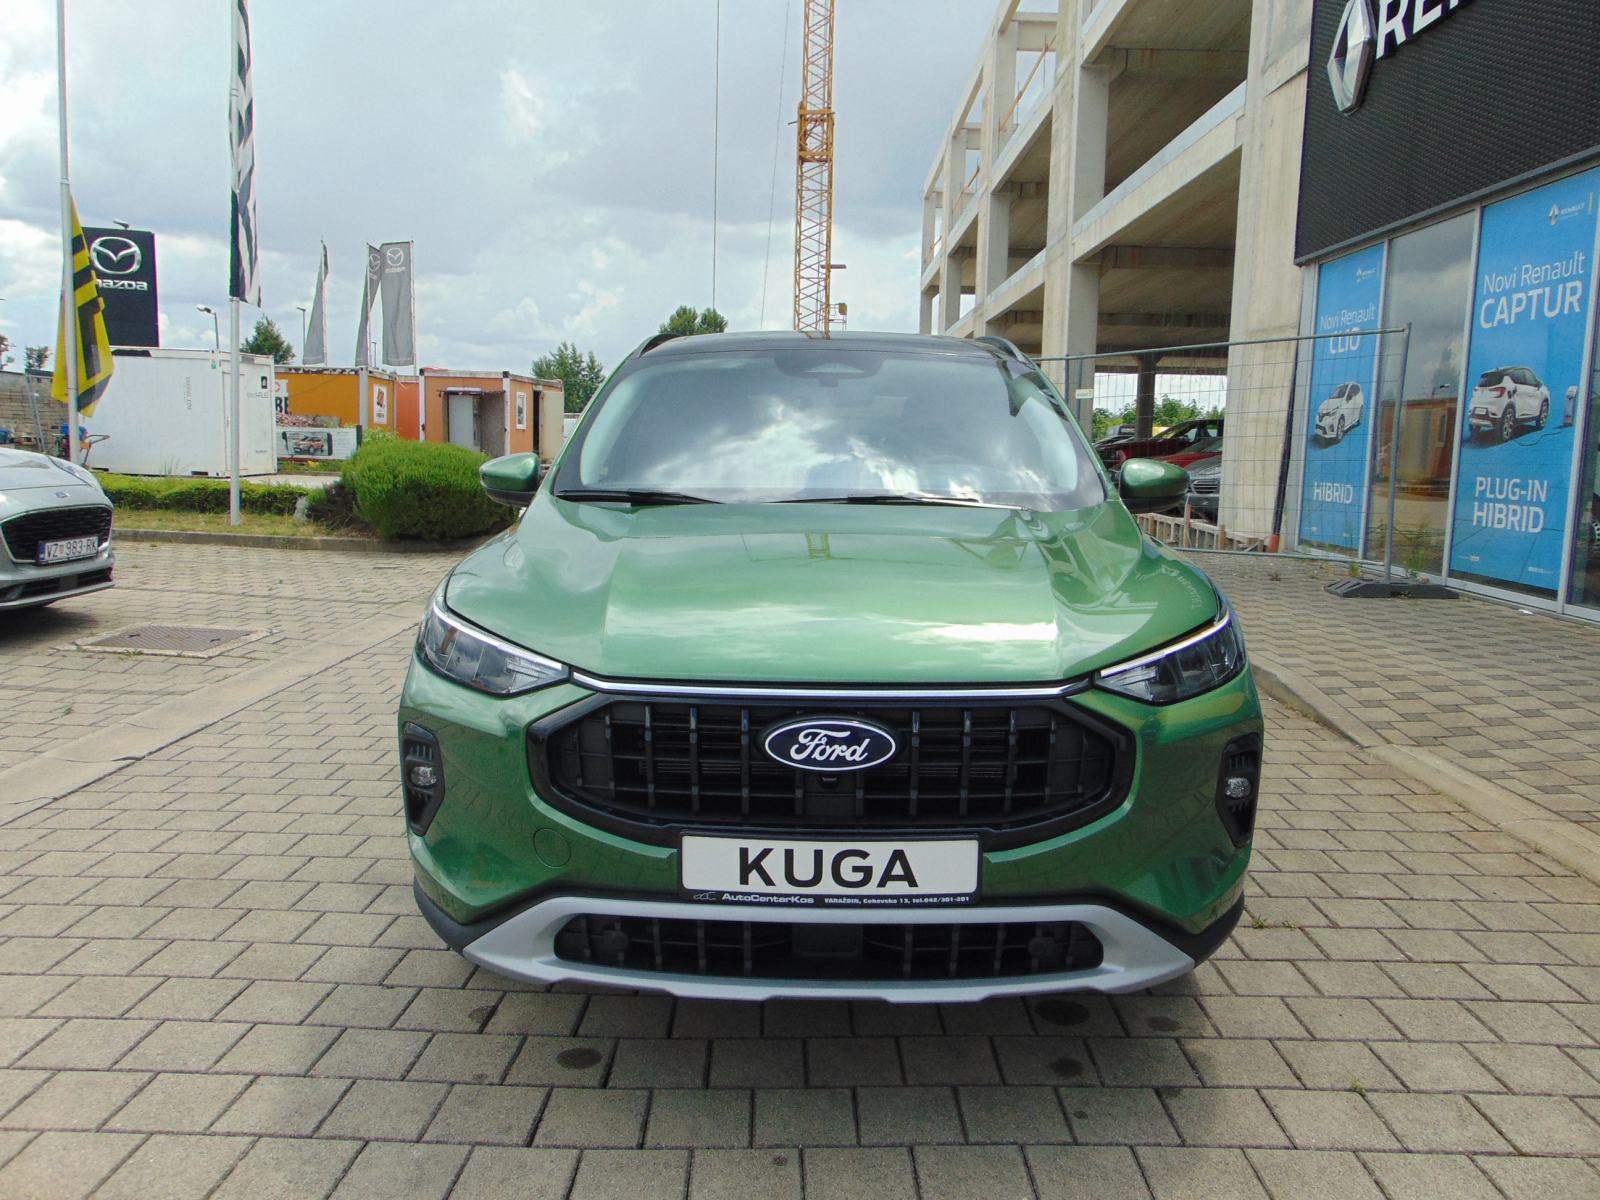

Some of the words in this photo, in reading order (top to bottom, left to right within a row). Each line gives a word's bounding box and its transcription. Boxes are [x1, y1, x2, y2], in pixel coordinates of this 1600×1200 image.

[1483, 272, 1517, 294] Novi
[1520, 251, 1585, 288] Renault
[1320, 313, 1340, 331] Novi
[1341, 302, 1376, 327] Renault
[1480, 280, 1583, 329] CAPTUR
[1330, 327, 1361, 354] CLIO
[1313, 481, 1354, 504] HIBRID
[1475, 477, 1548, 502] PLUG-IN
[1473, 502, 1545, 533] HIBRID
[789, 728, 871, 762] Ford
[739, 847, 919, 888] KUGA
